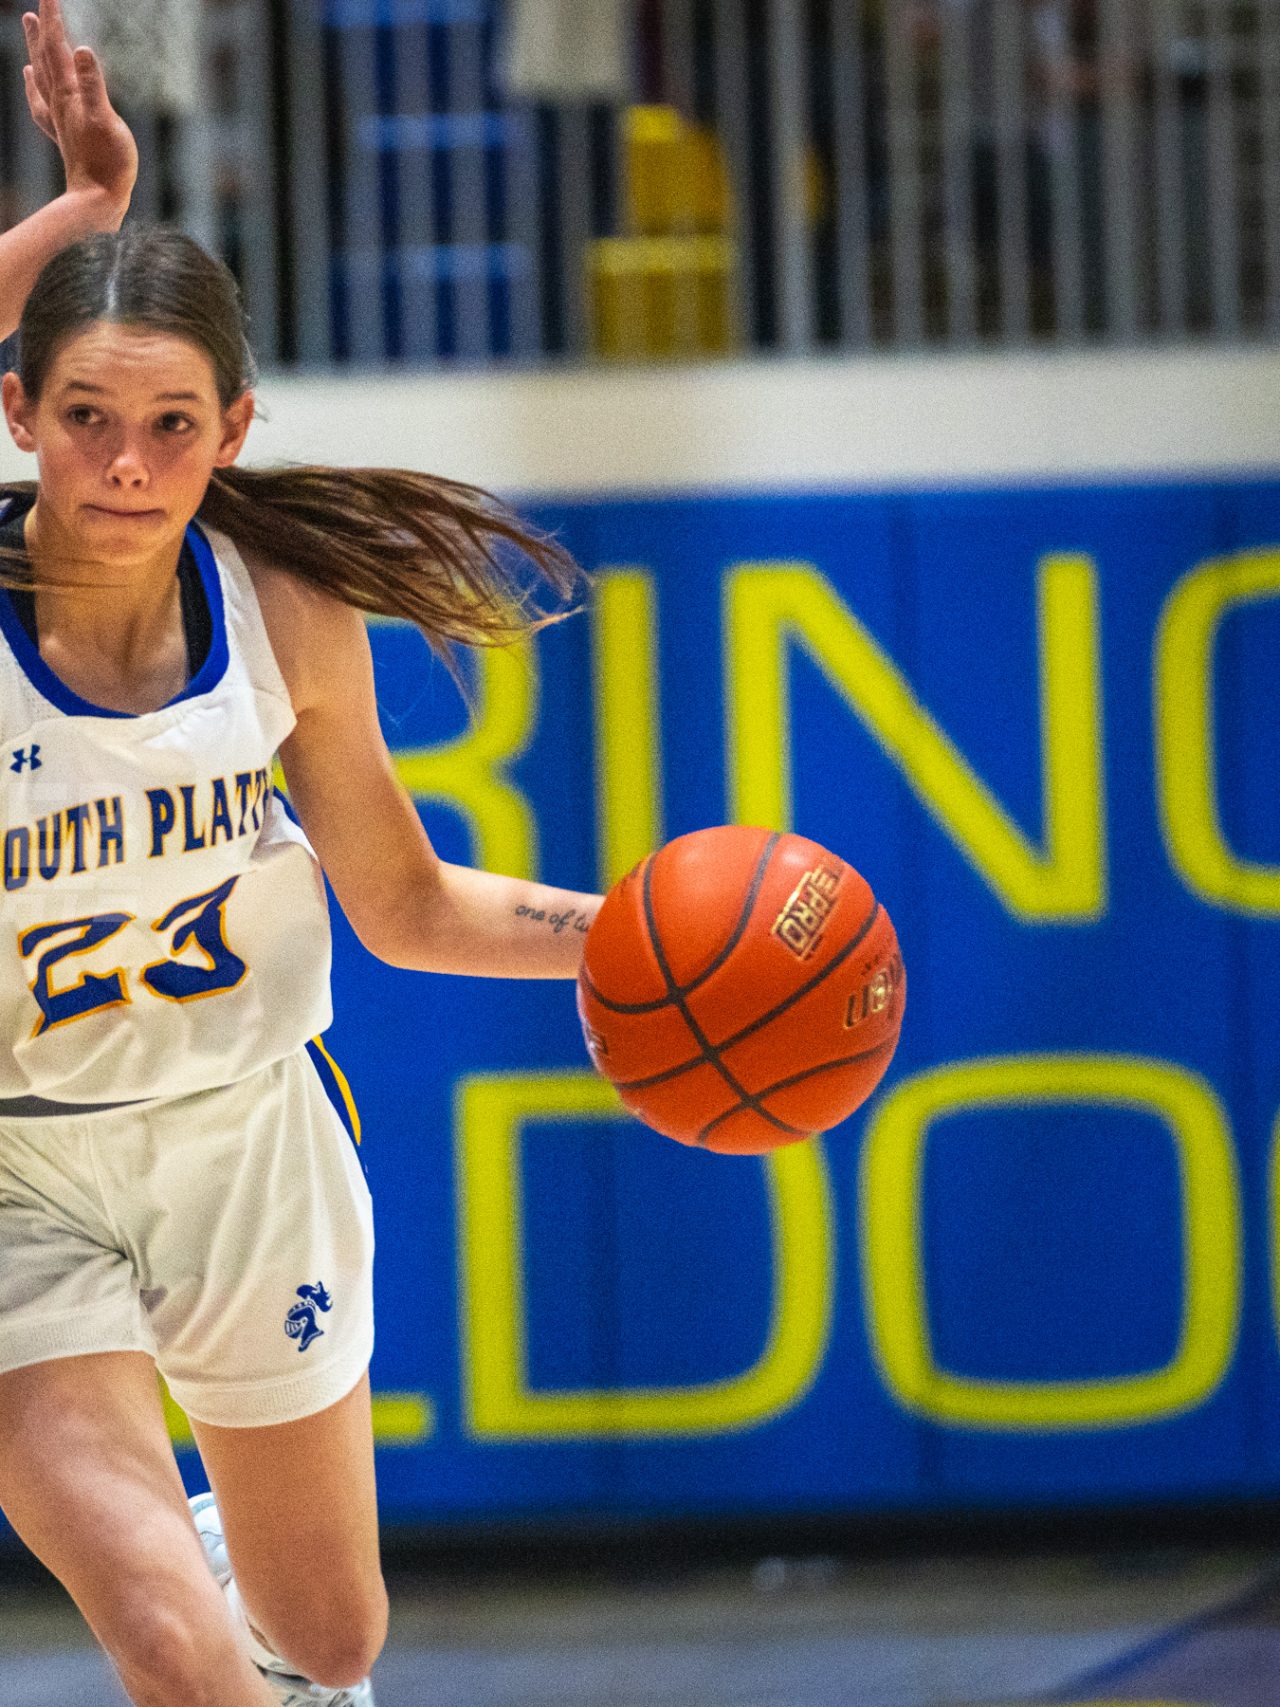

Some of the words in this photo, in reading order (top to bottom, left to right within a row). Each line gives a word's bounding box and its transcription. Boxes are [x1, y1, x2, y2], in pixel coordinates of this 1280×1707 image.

[17, 874, 250, 1040] 23
[514, 904, 546, 921] one
[548, 909, 577, 934] of
